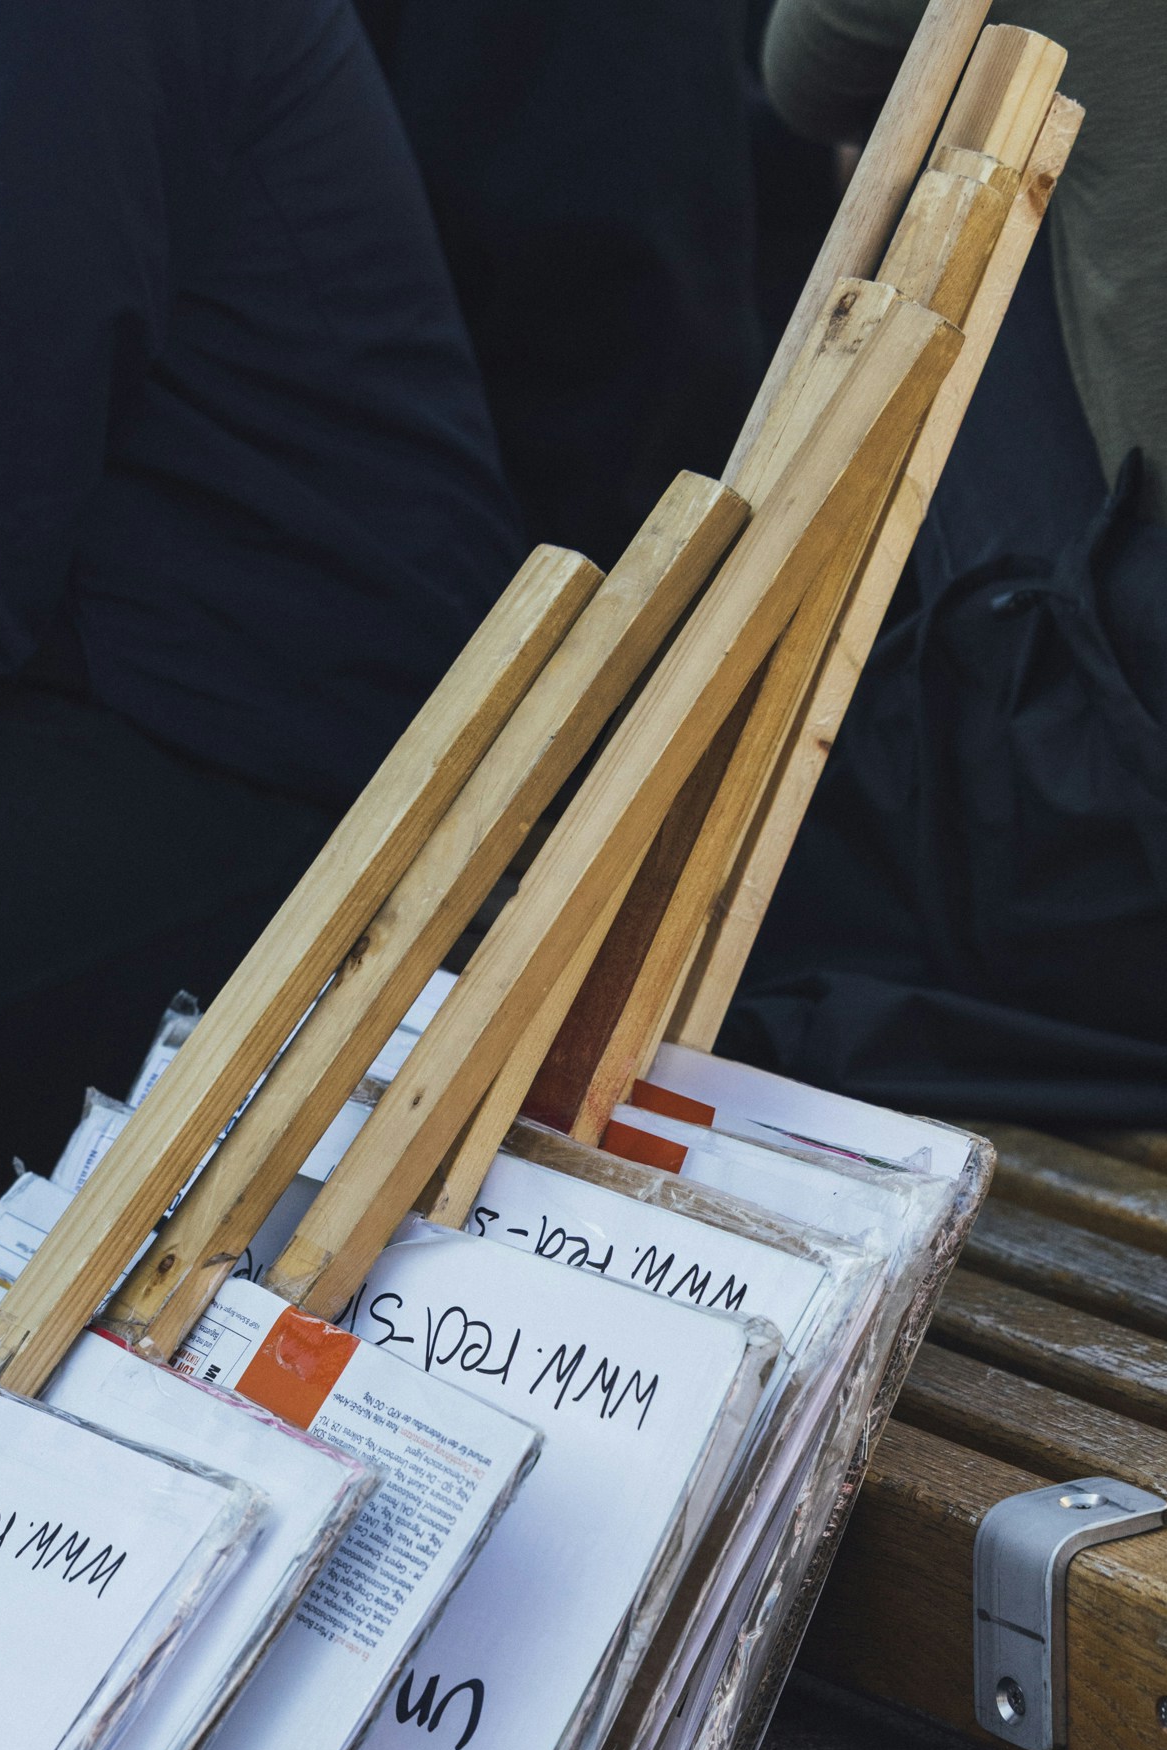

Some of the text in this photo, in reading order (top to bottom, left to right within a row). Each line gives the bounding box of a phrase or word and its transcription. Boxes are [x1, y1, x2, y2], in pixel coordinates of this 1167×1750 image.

[372, 1413, 385, 1424] Hilfe
[386, 1407, 401, 1419] KPD
[385, 1419, 398, 1433] Rote
